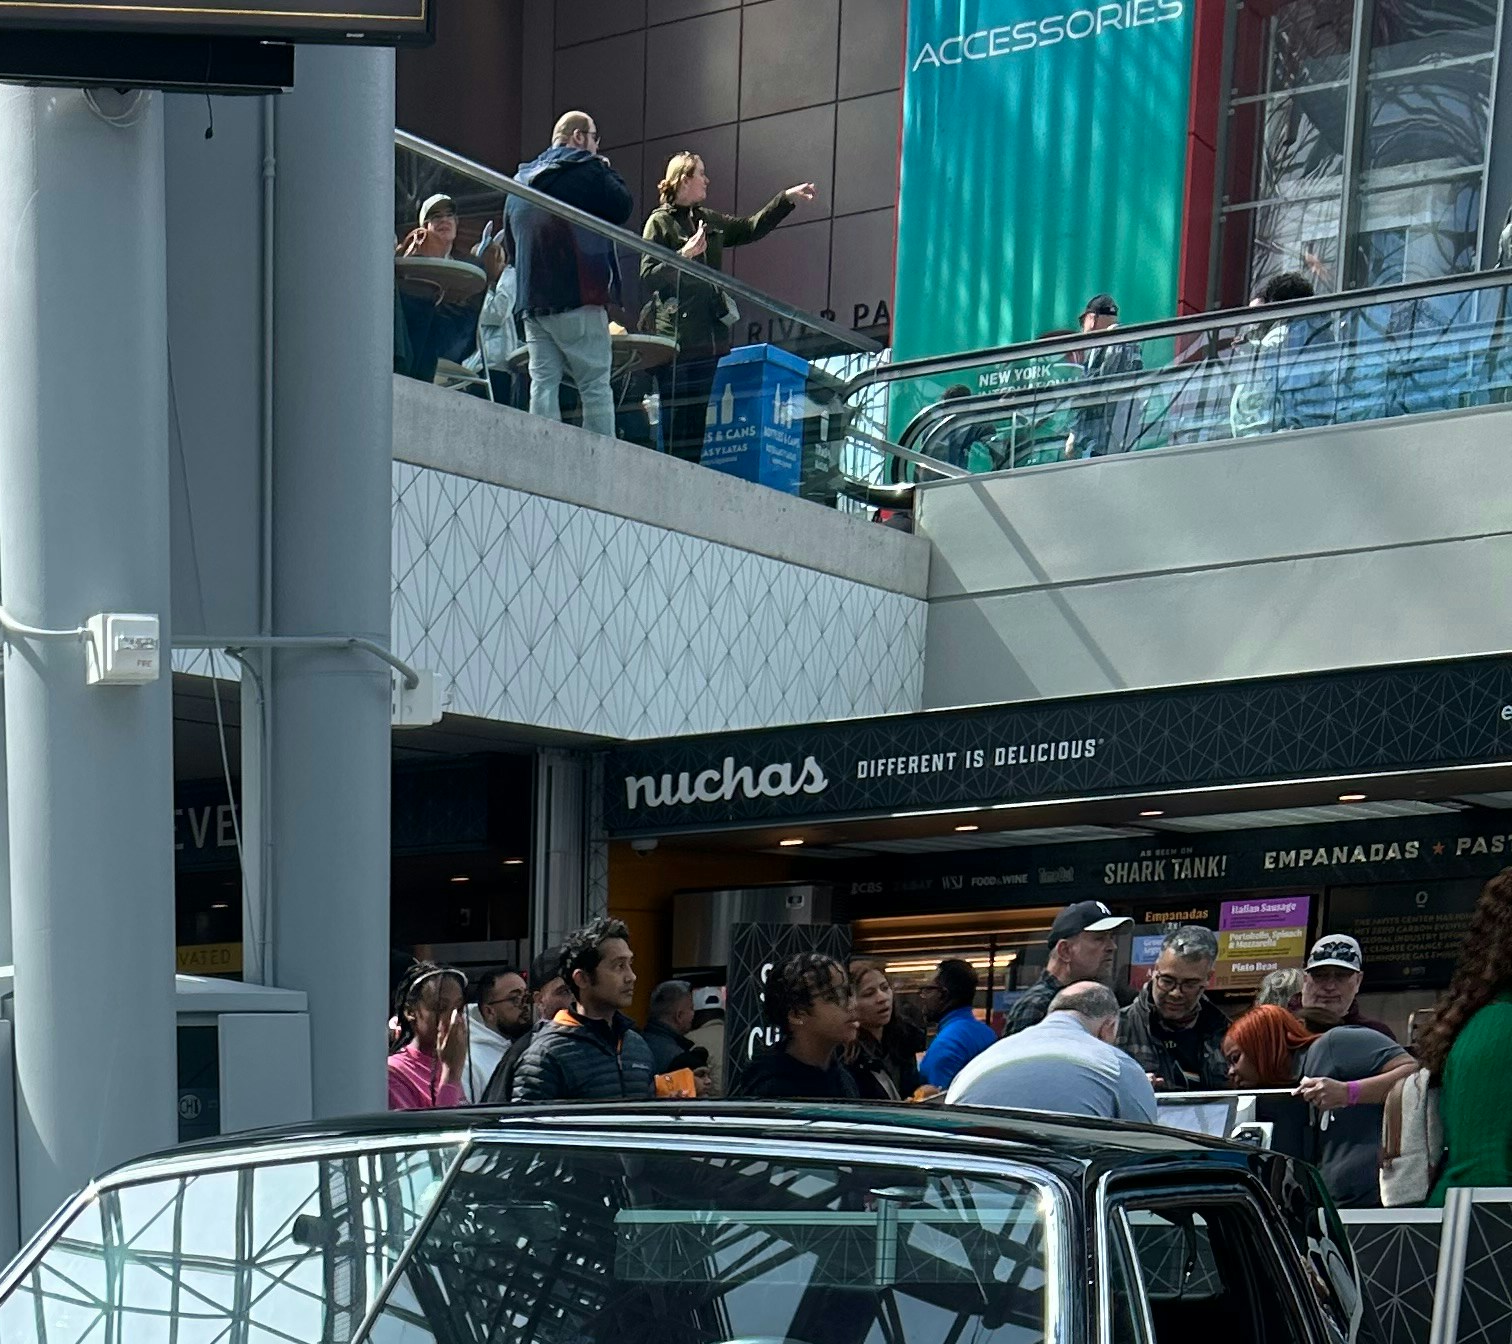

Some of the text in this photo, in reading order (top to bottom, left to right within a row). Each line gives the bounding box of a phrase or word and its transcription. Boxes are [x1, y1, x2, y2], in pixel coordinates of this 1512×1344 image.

[912, 0, 1183, 72] ACCESSORIES
[978, 364, 1052, 388] NEW YORK
[625, 755, 828, 810] nuchas
[857, 751, 957, 780] DIFFERENT
[965, 749, 985, 770] IS
[1104, 855, 1228, 885] SHARK TANK!
[1263, 840, 1420, 871] EMPANADAS
[1144, 908, 1209, 924] Empanadas
